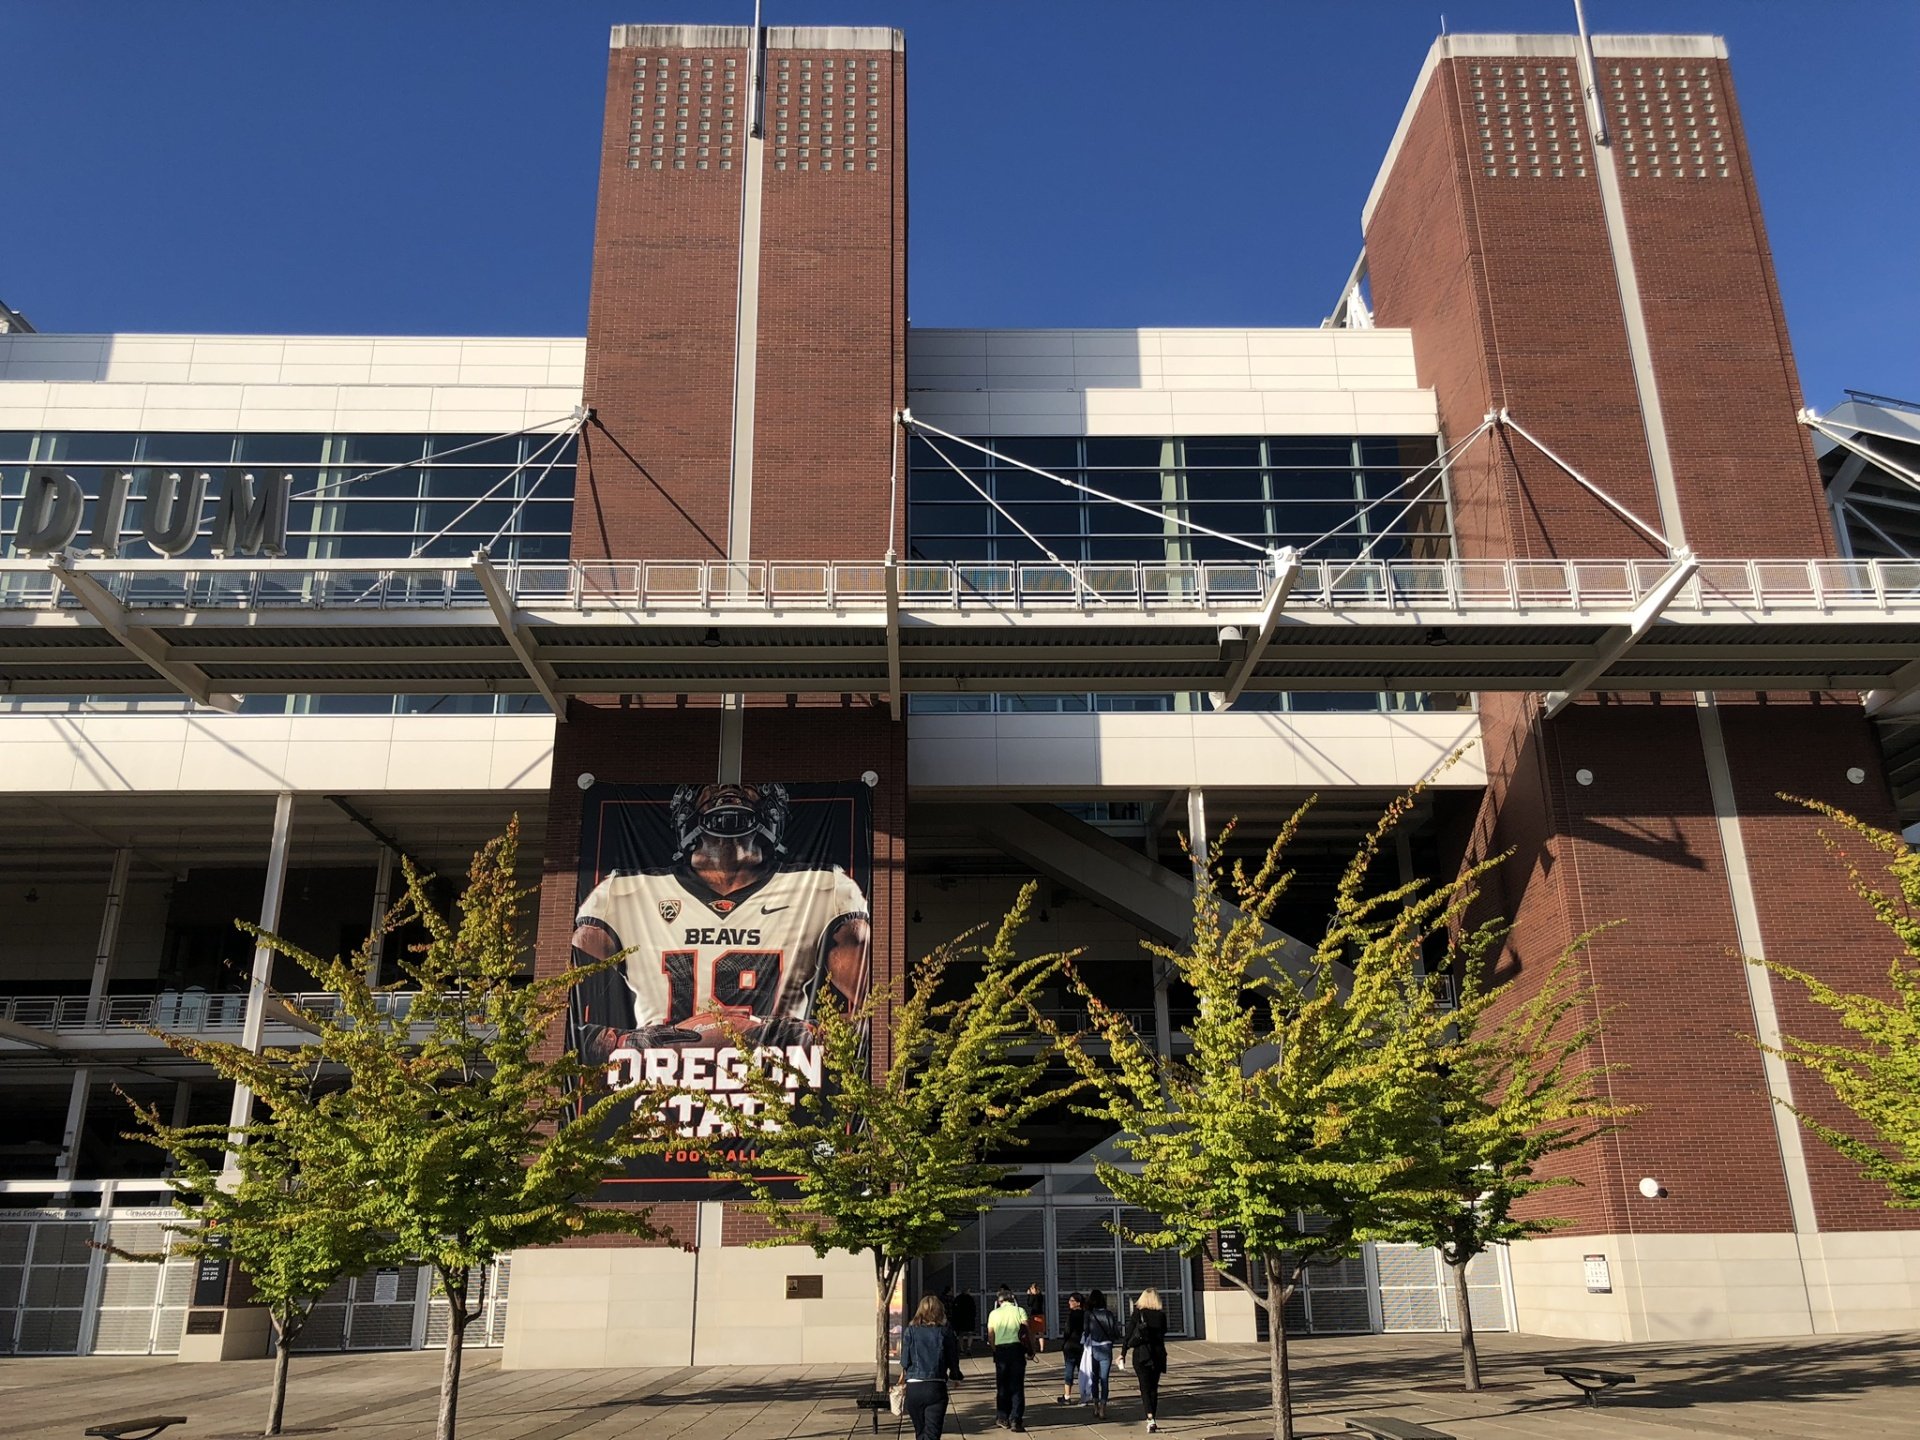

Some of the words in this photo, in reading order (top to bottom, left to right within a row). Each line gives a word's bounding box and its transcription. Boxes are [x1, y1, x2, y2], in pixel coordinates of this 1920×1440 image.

[684, 927, 761, 946] BEAVS
[661, 948, 784, 1025] 19
[607, 1045, 825, 1091] OREGON
[664, 1149, 760, 1163] FOOALL
[981, 1196, 998, 1204] Only
